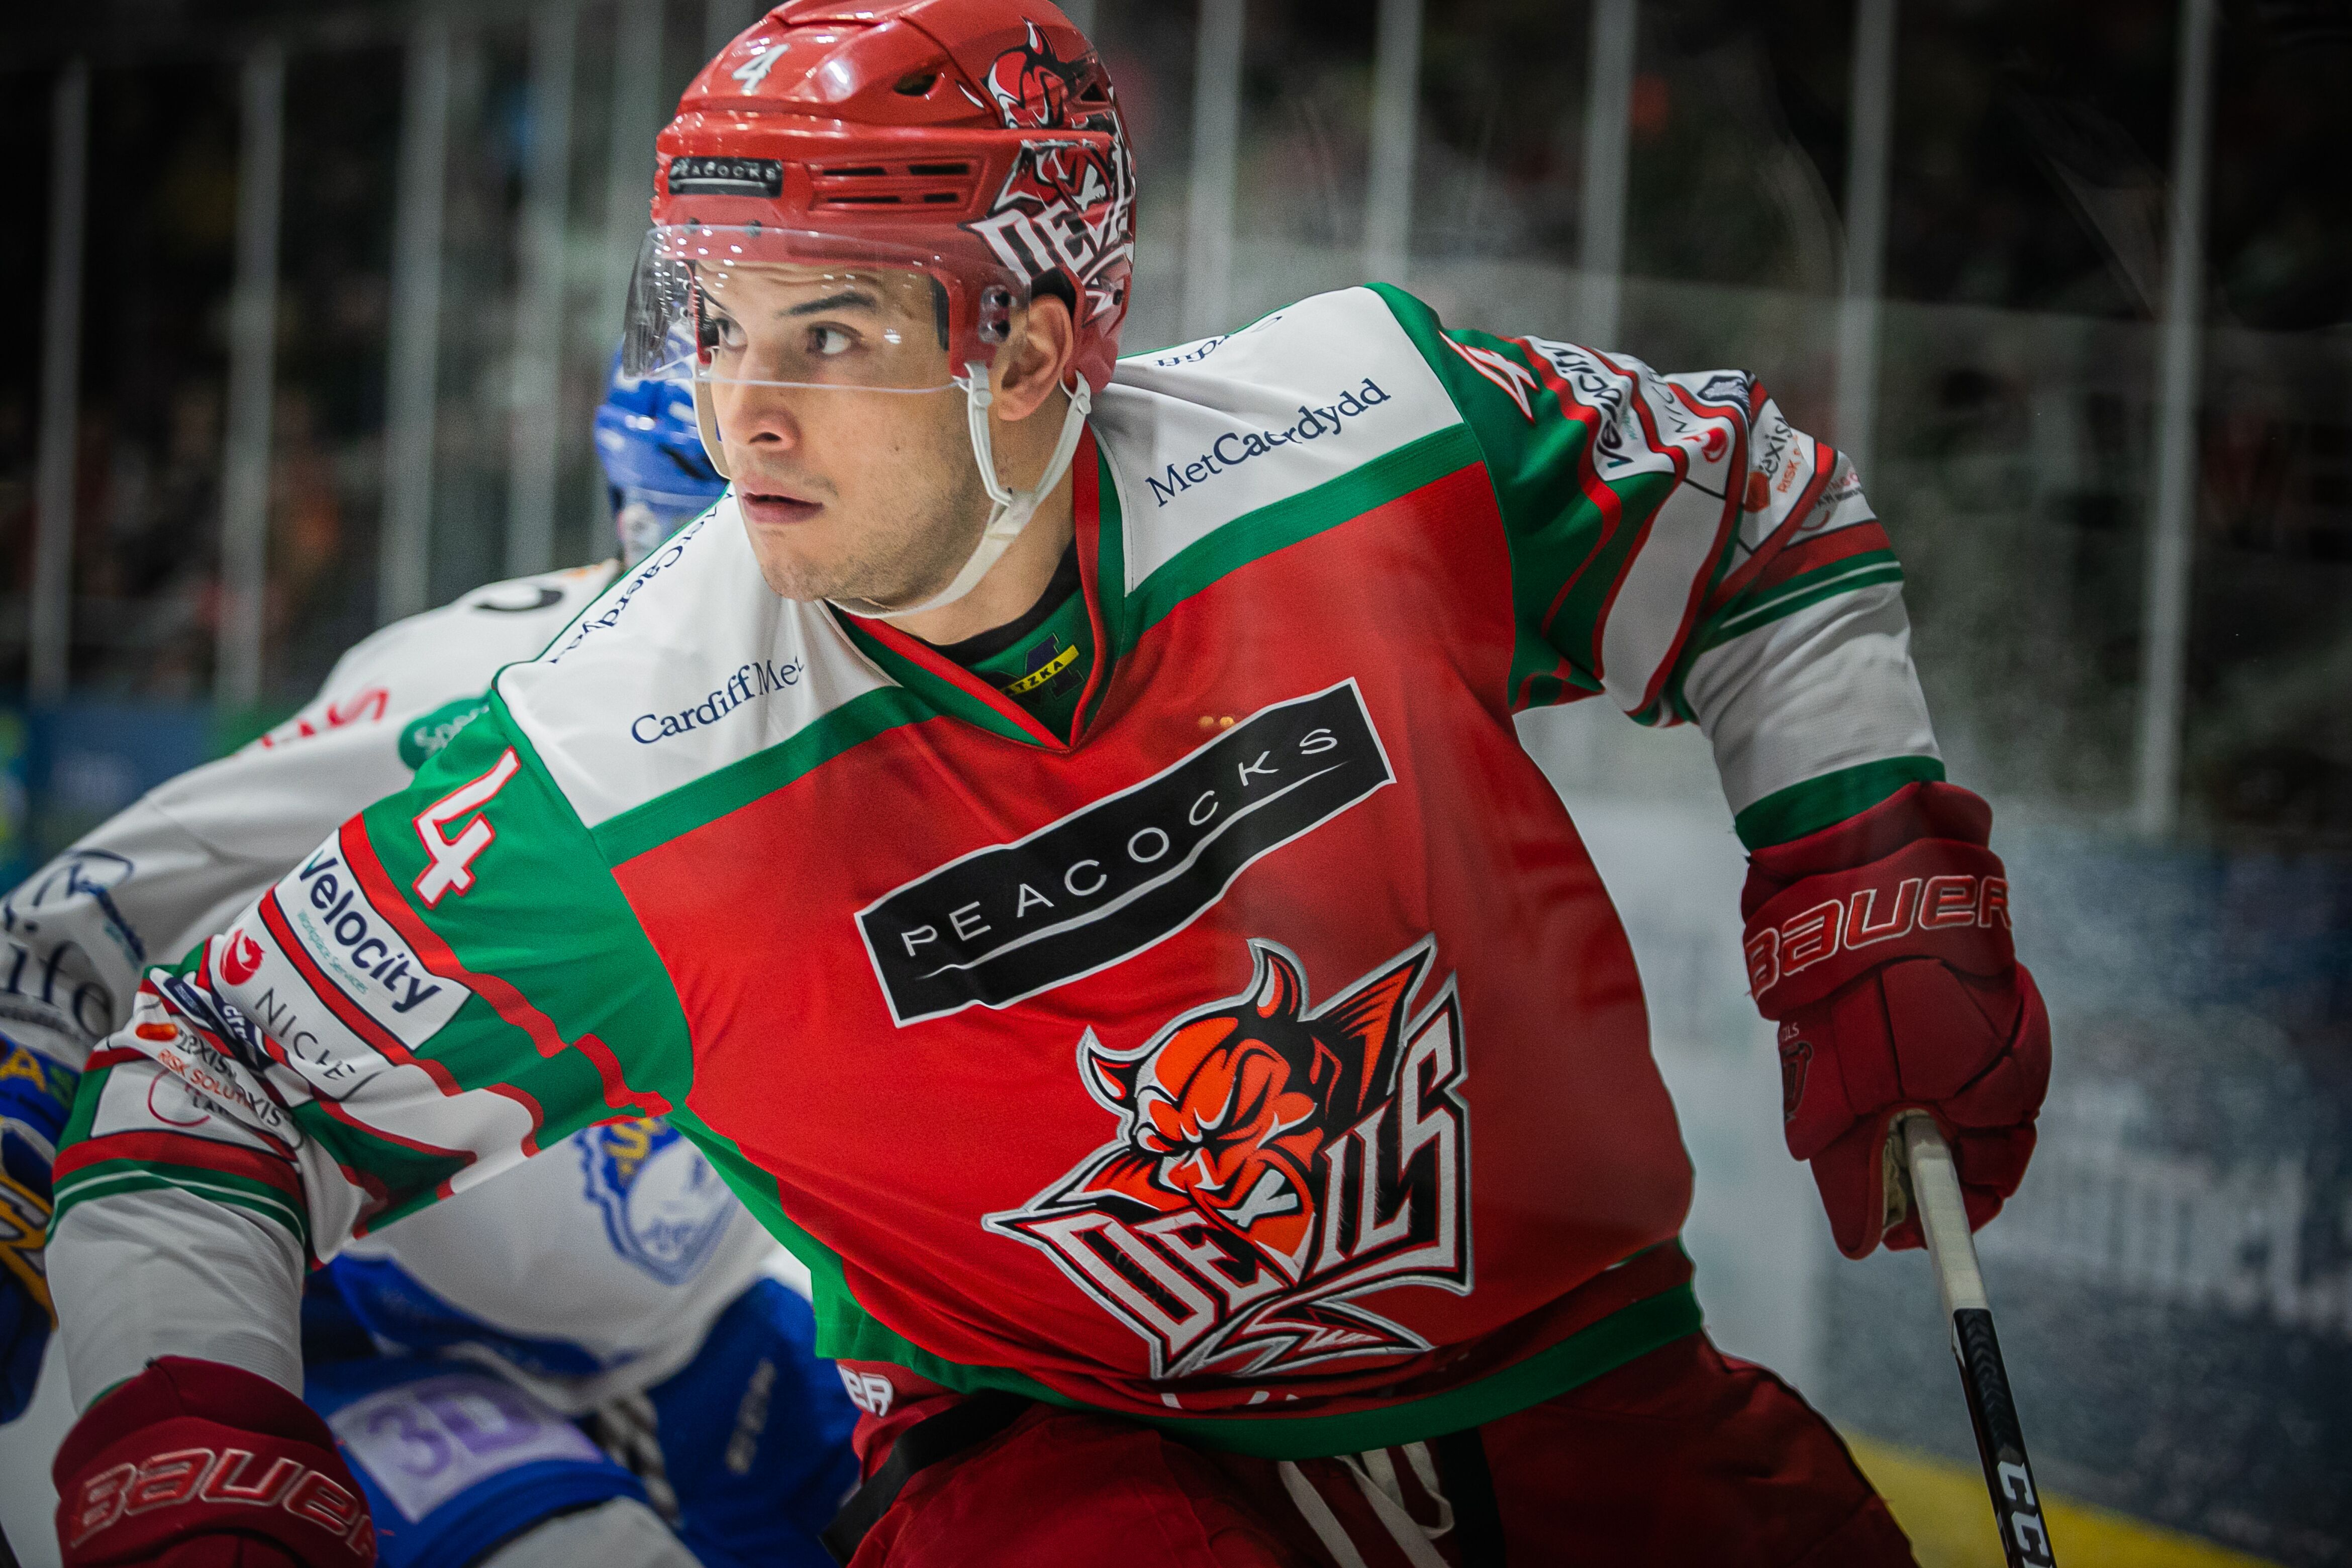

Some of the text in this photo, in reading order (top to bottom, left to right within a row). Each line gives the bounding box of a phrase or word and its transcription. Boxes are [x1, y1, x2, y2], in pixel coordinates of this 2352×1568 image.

[732, 43, 790, 96] 4
[1438, 330, 1540, 424] 4
[412, 746, 522, 911] 4
[900, 728, 1338, 957] PEACOCKS
[299, 849, 443, 1013] Velocity
